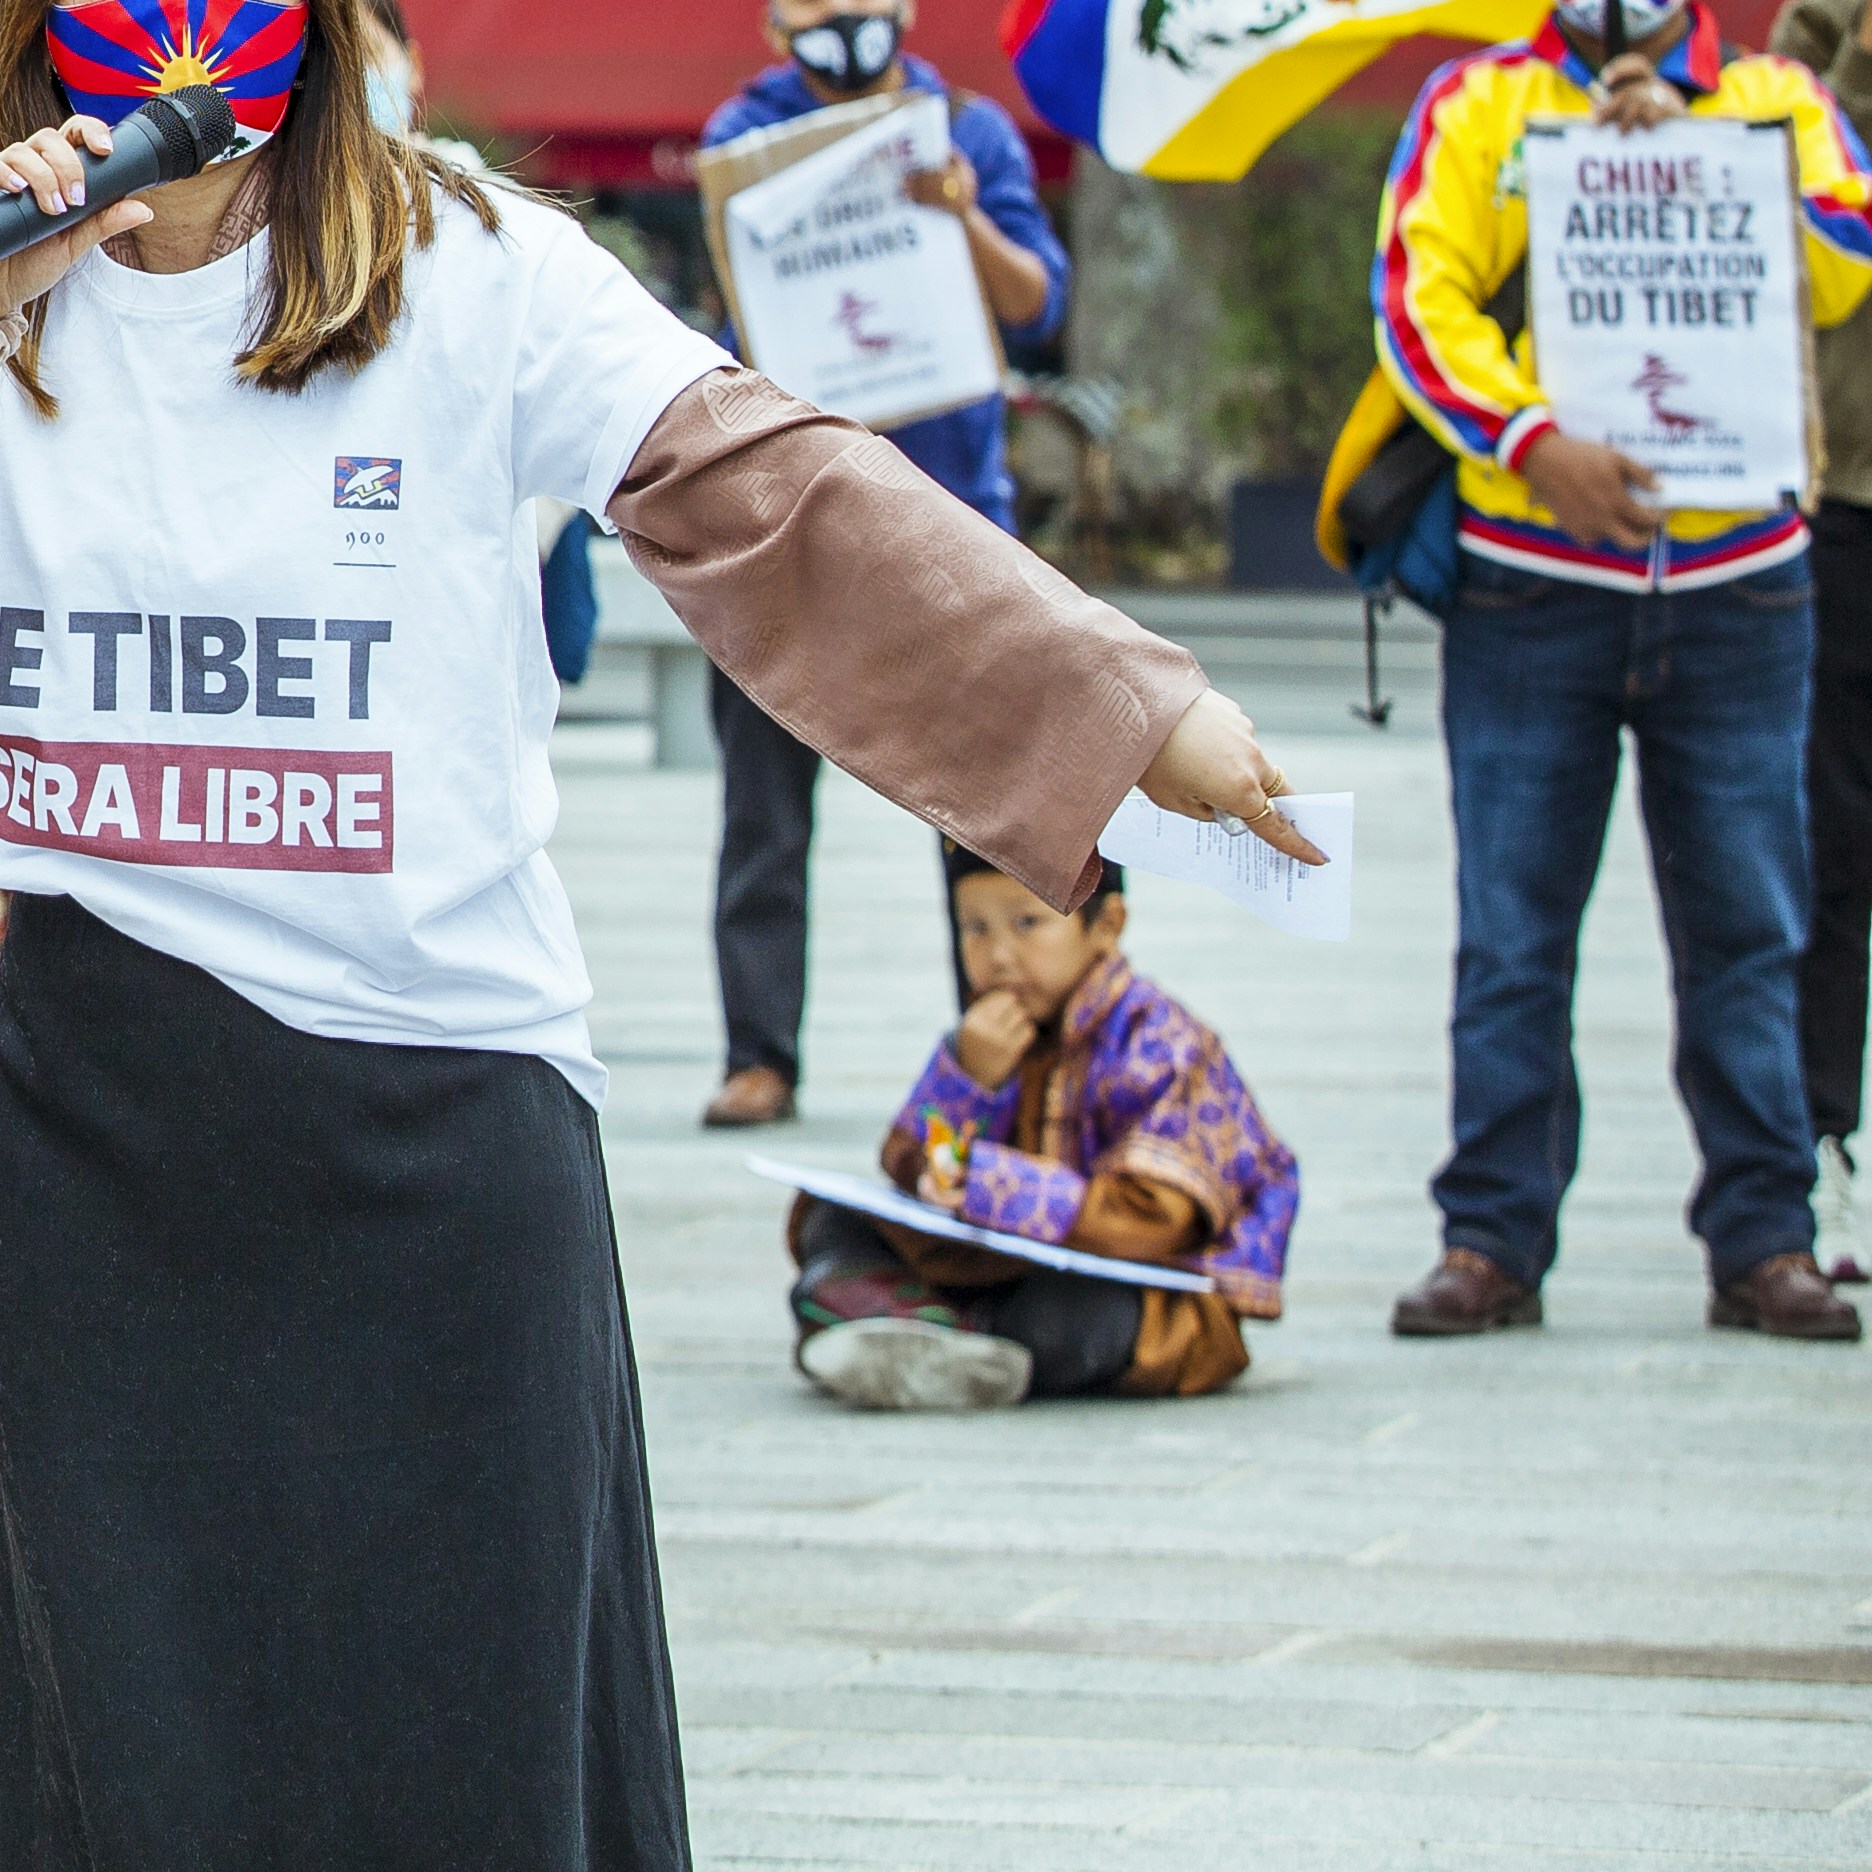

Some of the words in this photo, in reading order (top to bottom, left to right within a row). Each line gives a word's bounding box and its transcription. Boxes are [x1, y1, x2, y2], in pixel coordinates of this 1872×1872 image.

[1577, 154, 1705, 197] CHINE
[1565, 197, 1755, 243] ARRÊTEZ
[1557, 251, 1767, 280] L'OCCUPATION
[1568, 286, 1624, 327] DU
[1640, 285, 1759, 327] TIBET
[68, 611, 392, 720] TIBET
[158, 766, 383, 849] LIBRE
